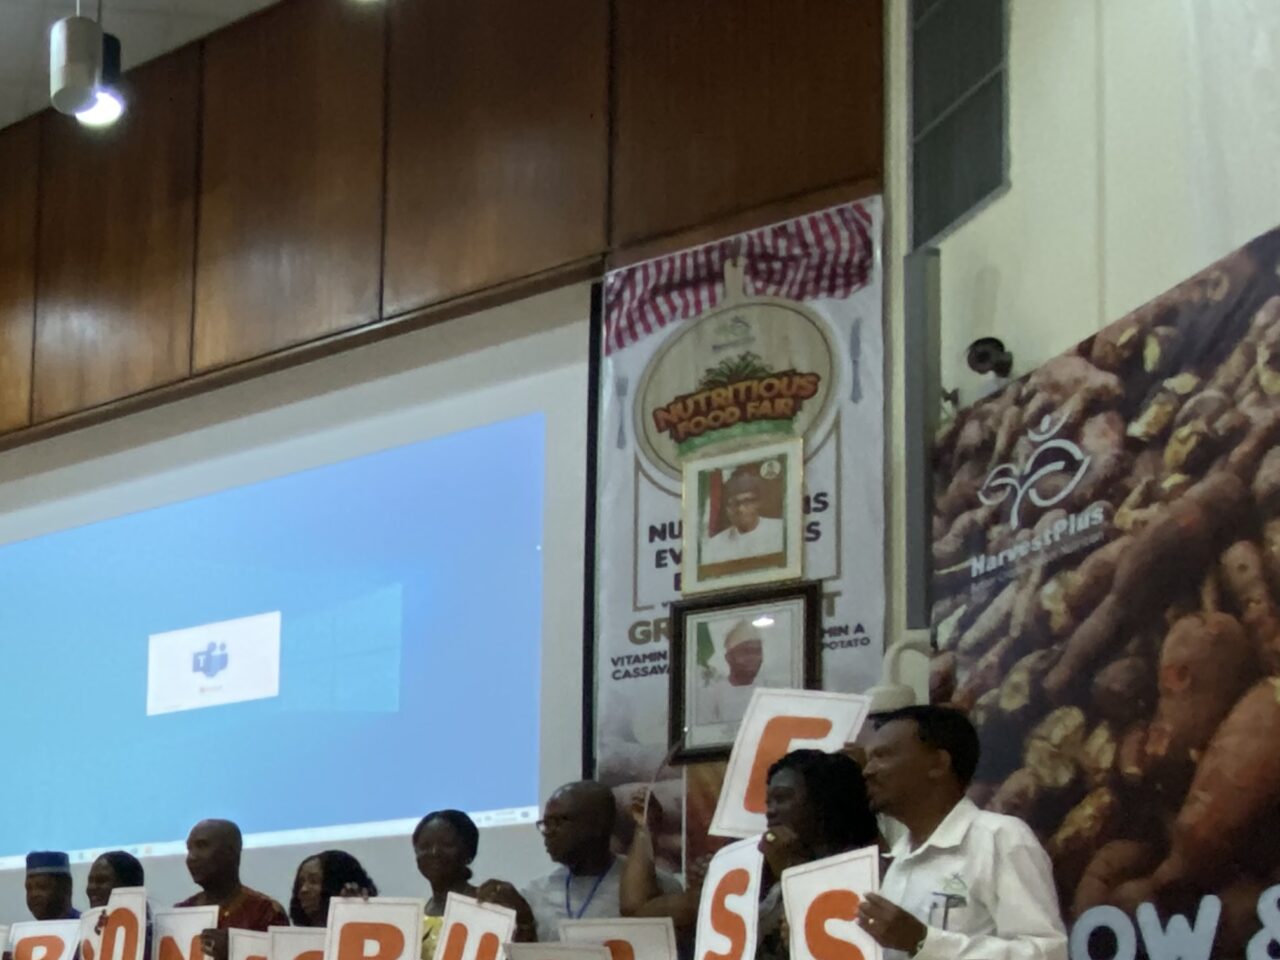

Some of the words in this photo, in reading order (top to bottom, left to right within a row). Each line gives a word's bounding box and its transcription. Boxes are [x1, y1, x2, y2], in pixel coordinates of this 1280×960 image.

[654, 373, 819, 433] NUTRITIOUS
[675, 405, 741, 442] FOOD
[746, 398, 795, 420] FAIR
